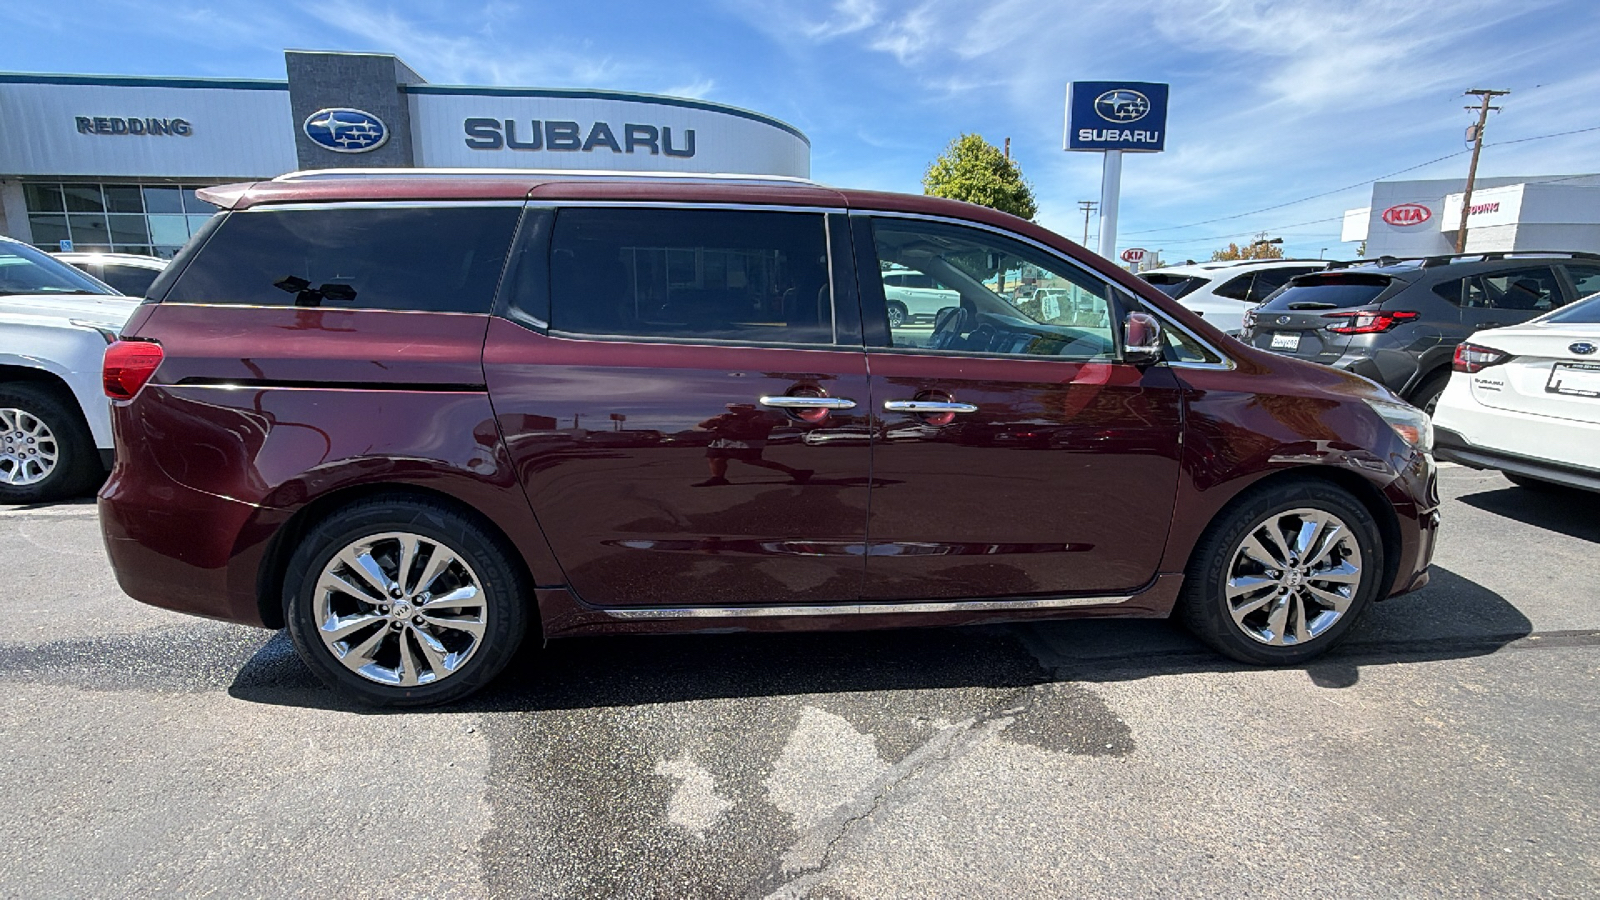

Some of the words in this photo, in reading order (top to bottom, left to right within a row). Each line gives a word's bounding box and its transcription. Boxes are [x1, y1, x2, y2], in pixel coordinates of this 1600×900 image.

[75, 116, 192, 137] REDDING
[464, 117, 697, 158] SUBARU
[1078, 128, 1159, 143] SUBARU
[1391, 209, 1423, 221] KIA
[1468, 202, 1500, 215] DDING
[394, 604, 410, 617] KIA
